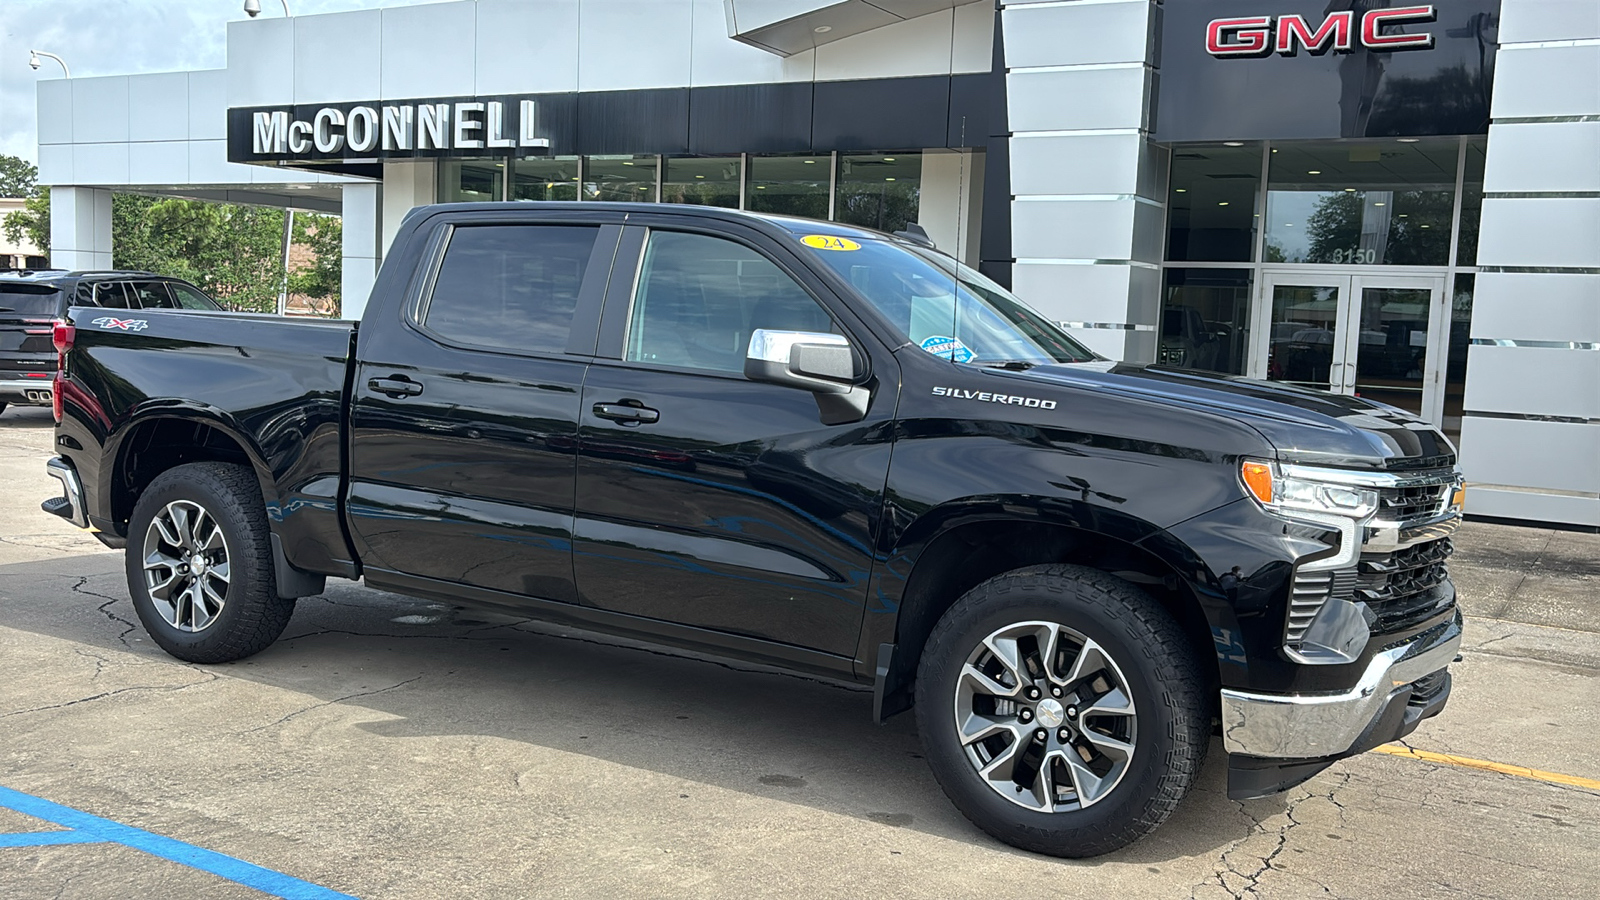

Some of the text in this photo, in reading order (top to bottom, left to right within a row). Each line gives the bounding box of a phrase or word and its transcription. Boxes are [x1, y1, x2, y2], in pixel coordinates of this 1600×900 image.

[1205, 4, 1436, 56] GMC
[253, 100, 549, 154] McCONNELL
[817, 236, 845, 249] 24
[931, 386, 1057, 410] SILVERADO
